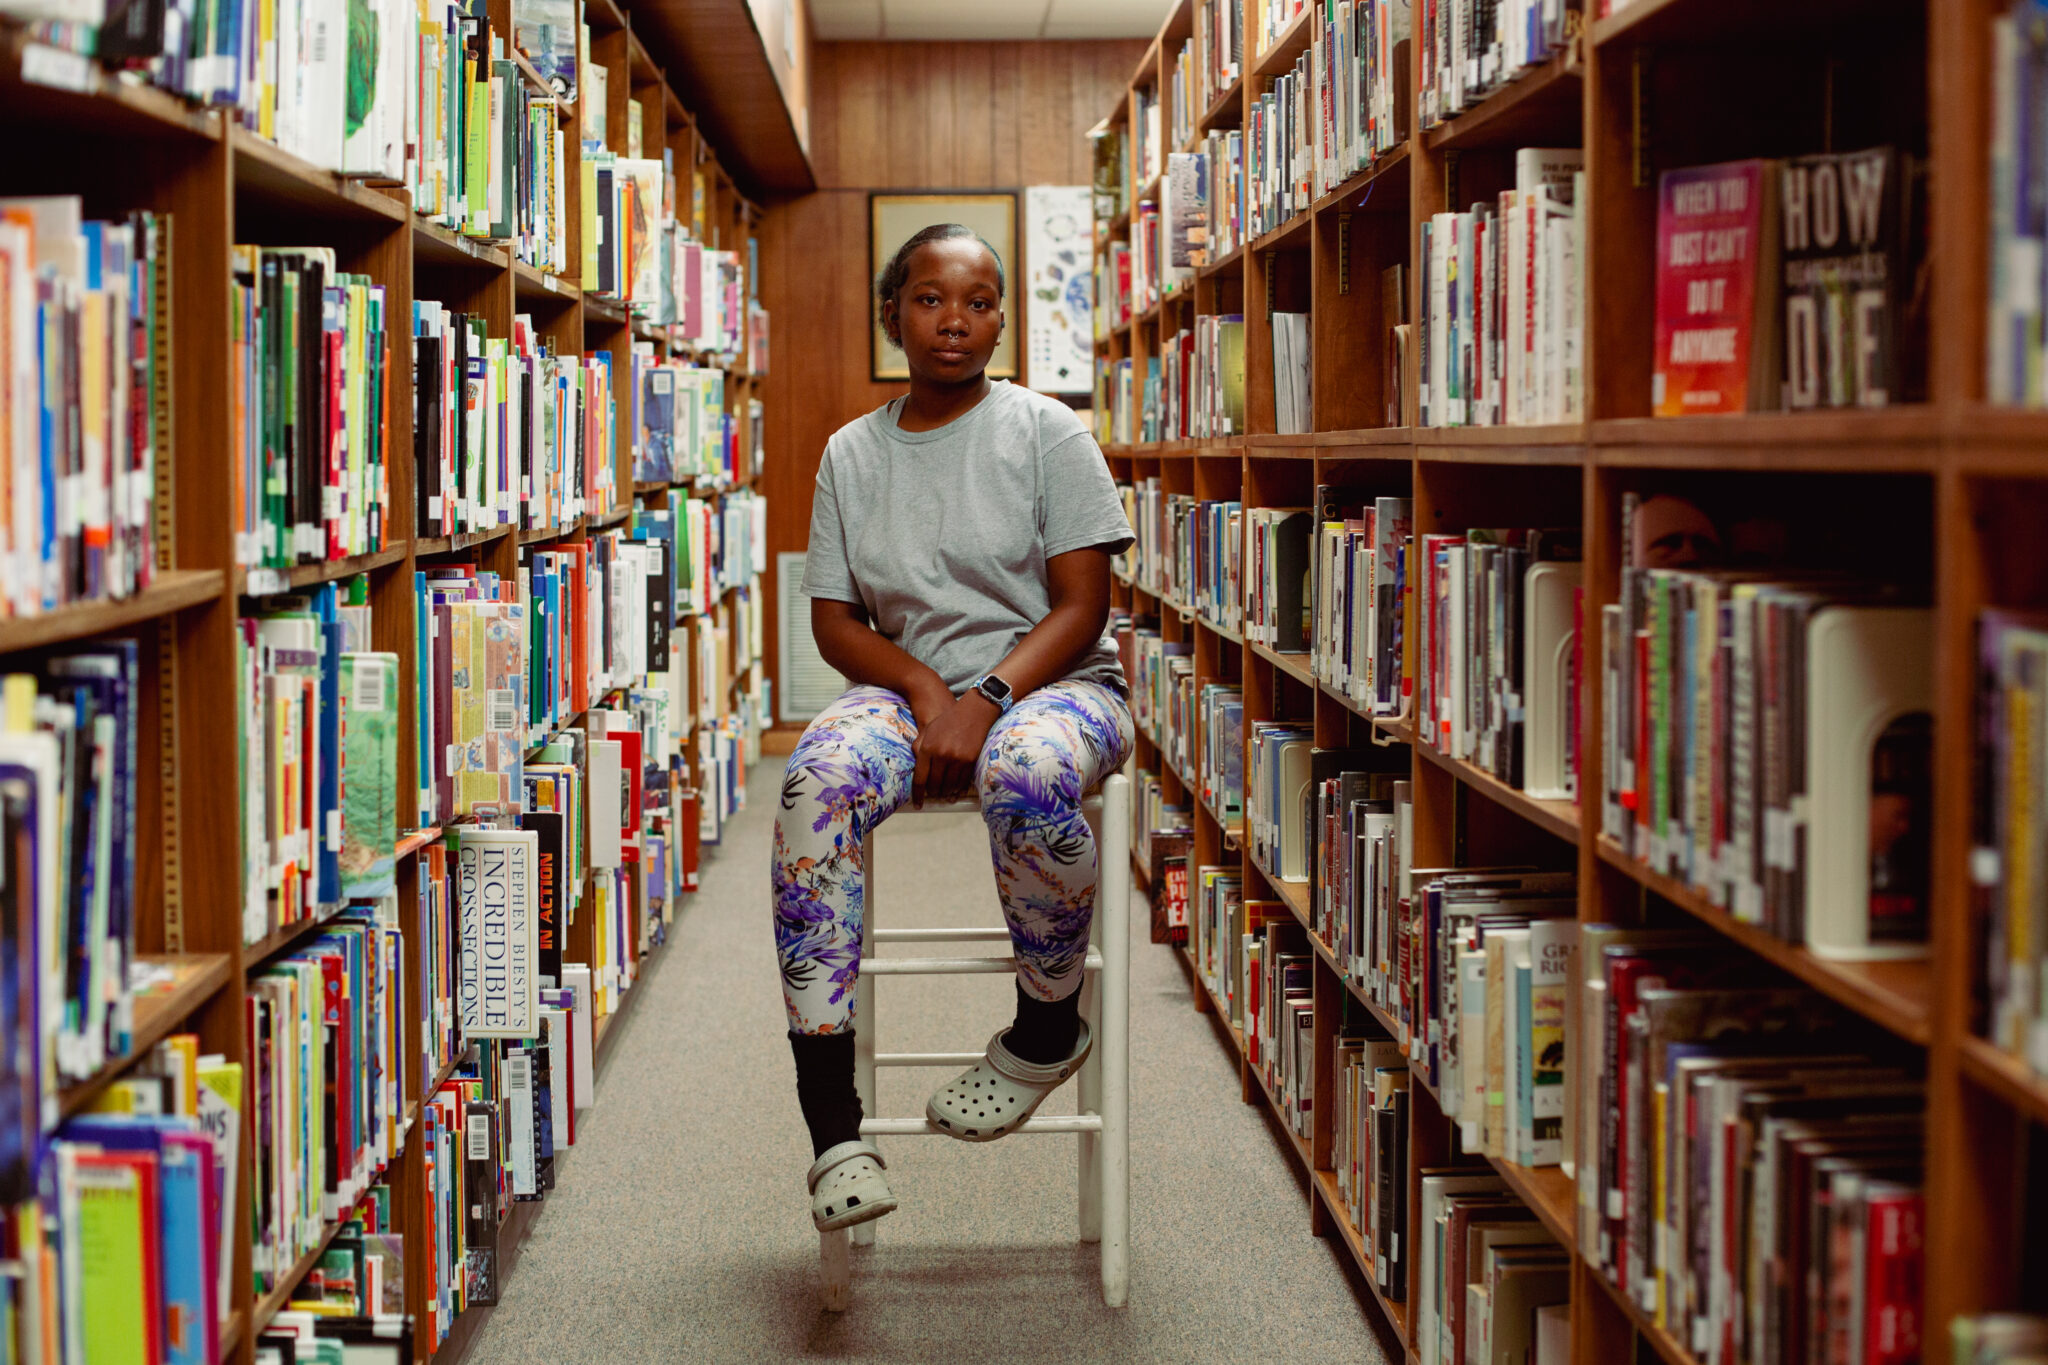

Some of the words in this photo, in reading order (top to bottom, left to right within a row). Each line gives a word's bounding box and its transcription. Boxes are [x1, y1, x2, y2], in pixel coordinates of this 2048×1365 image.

[1673, 181, 1716, 216] WHEN
[1718, 177, 1748, 212] YOU
[1783, 155, 1887, 250] HOW
[1669, 230, 1704, 267] JUST
[1705, 227, 1748, 263] CAN'T
[1687, 280, 1709, 314] DO
[1710, 278, 1727, 312] IT
[1669, 328, 1738, 364] ANYMORE
[1787, 290, 1888, 407] DIE
[511, 847, 525, 931] STEPHEN
[539, 852, 553, 925] ACTION
[461, 846, 479, 1026] CROSS-SECTIONS
[484, 847, 507, 1026] INCREDIBLE
[539, 930, 553, 949] IN
[1542, 942, 1577, 959] GR
[512, 944, 526, 1027] BIESTY'S
